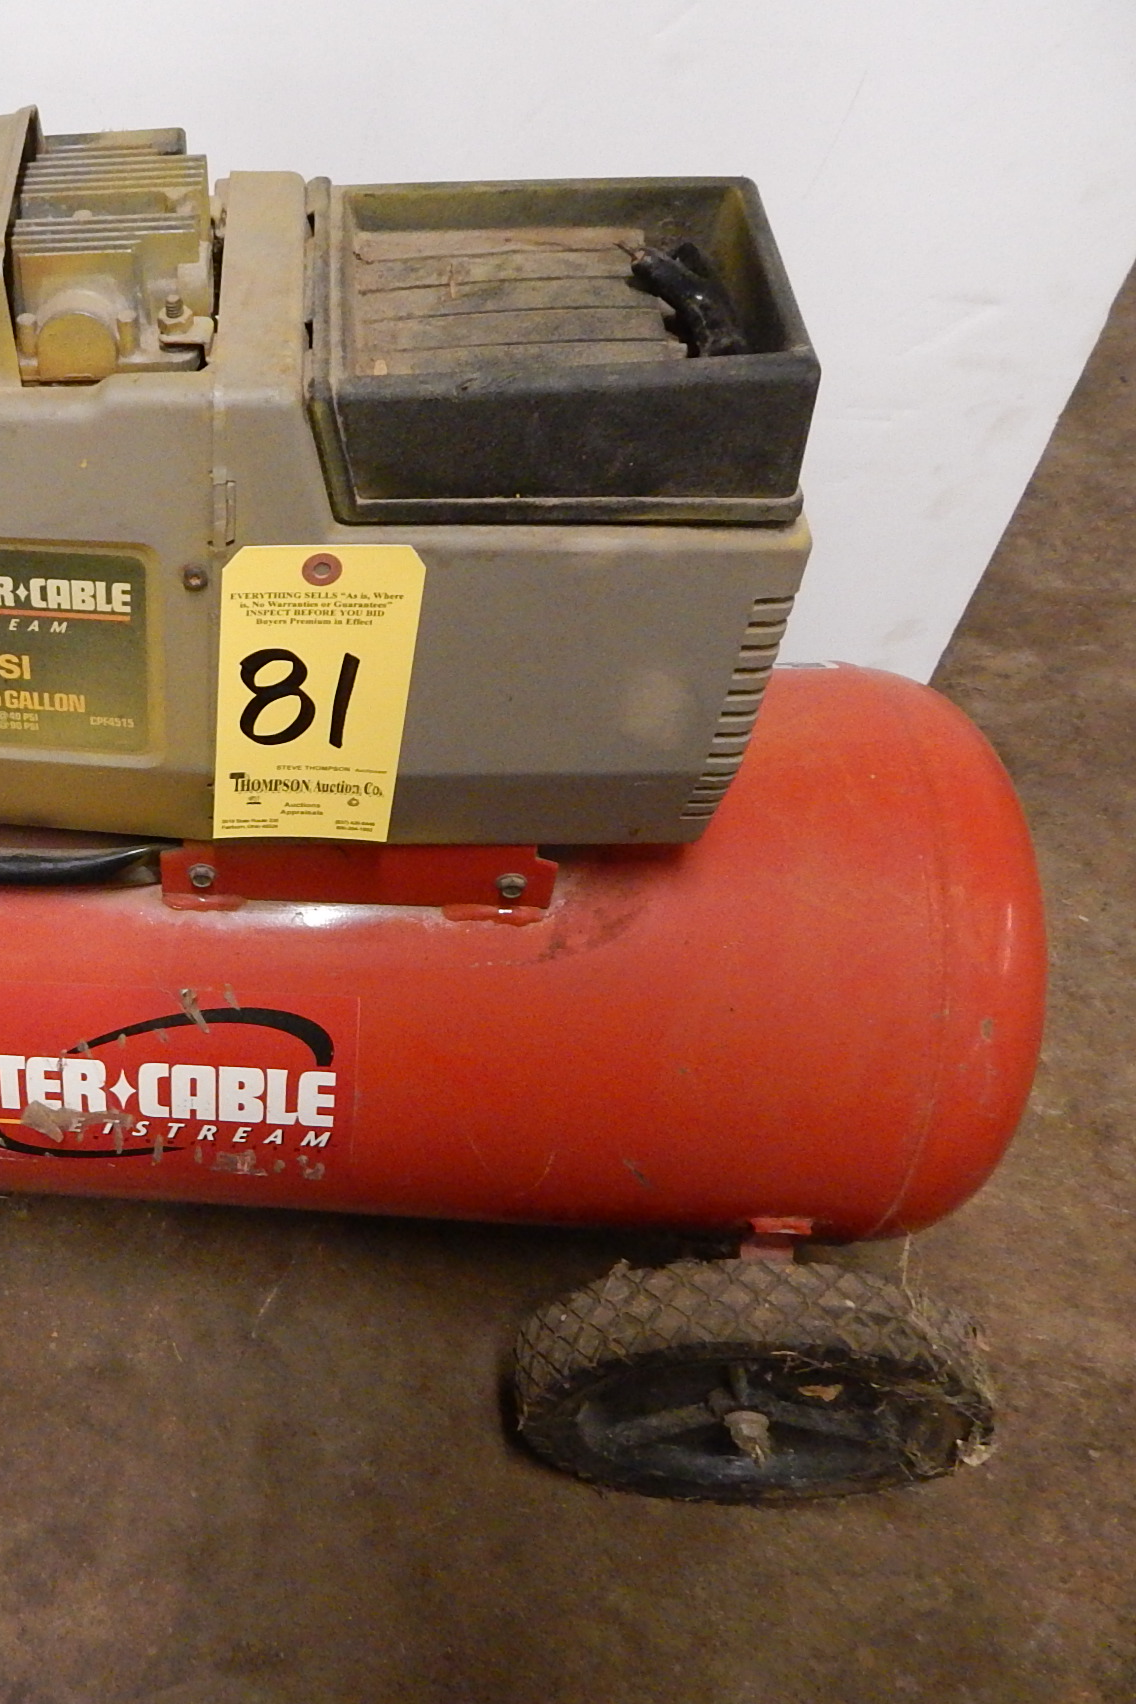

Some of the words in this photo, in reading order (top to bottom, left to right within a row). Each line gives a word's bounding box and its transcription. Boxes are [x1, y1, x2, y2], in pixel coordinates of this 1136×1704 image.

[29, 578, 132, 613] CABLE
[229, 591, 302, 600] EVERYTHING
[304, 592, 339, 600] SELLS
[373, 592, 405, 600] Where
[246, 609, 291, 617] INSPECT
[293, 609, 337, 617] BEFORE
[340, 609, 364, 617] YOU
[365, 609, 386, 617] BID
[255, 618, 288, 627] Buyers
[345, 618, 374, 626] Effect
[4, 690, 86, 712] GALLON
[239, 648, 360, 750] 81
[229, 772, 312, 793] THOMPSON
[314, 780, 363, 796] Auction
[138, 1062, 338, 1128] CABLE
[68, 1116, 332, 1148] ETSTREAM
